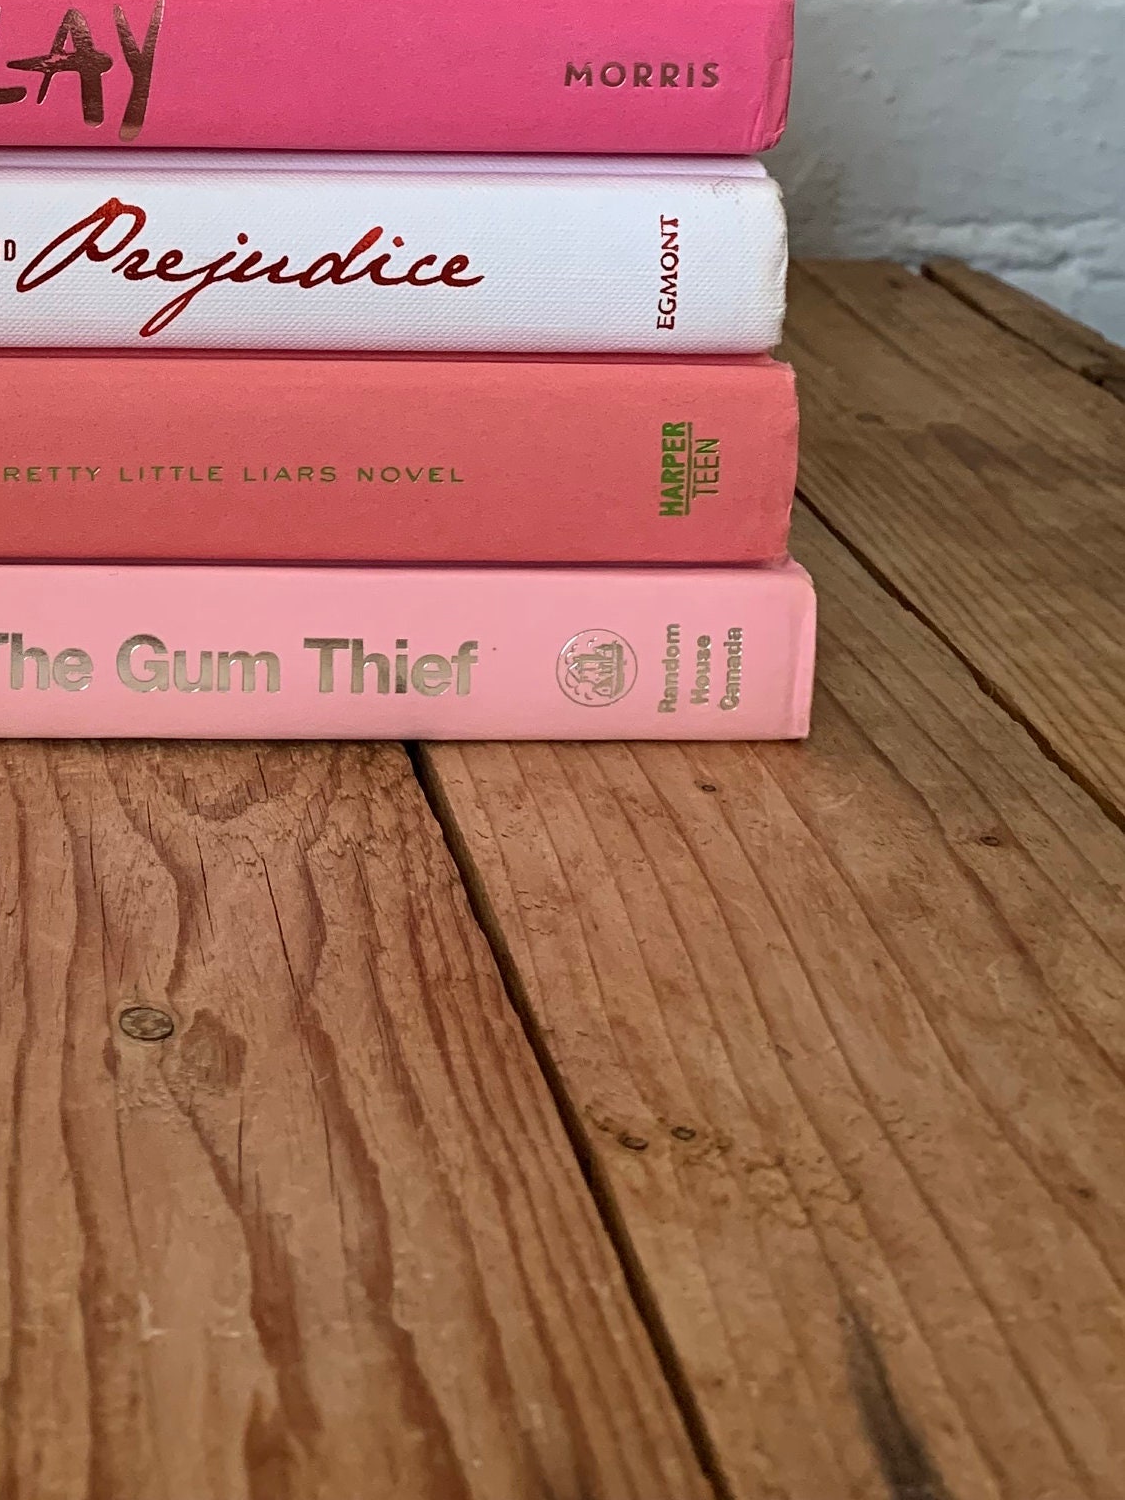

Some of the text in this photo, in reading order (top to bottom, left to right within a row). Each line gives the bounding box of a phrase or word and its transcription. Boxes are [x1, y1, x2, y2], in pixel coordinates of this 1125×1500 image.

[564, 61, 720, 88] MORRIS
[16, 197, 485, 337] Prejudice
[656, 214, 679, 330] EGMONT
[119, 466, 224, 483] LITTLE
[244, 466, 338, 484] LIARS
[357, 467, 466, 484] NOVEL
[659, 422, 686, 516] HARPER
[692, 438, 720, 500] TEEN
[116, 633, 281, 694] Gum
[303, 638, 479, 697] Thief
[657, 623, 681, 713] Random
[690, 634, 712, 705] House
[718, 627, 743, 711] Canada
